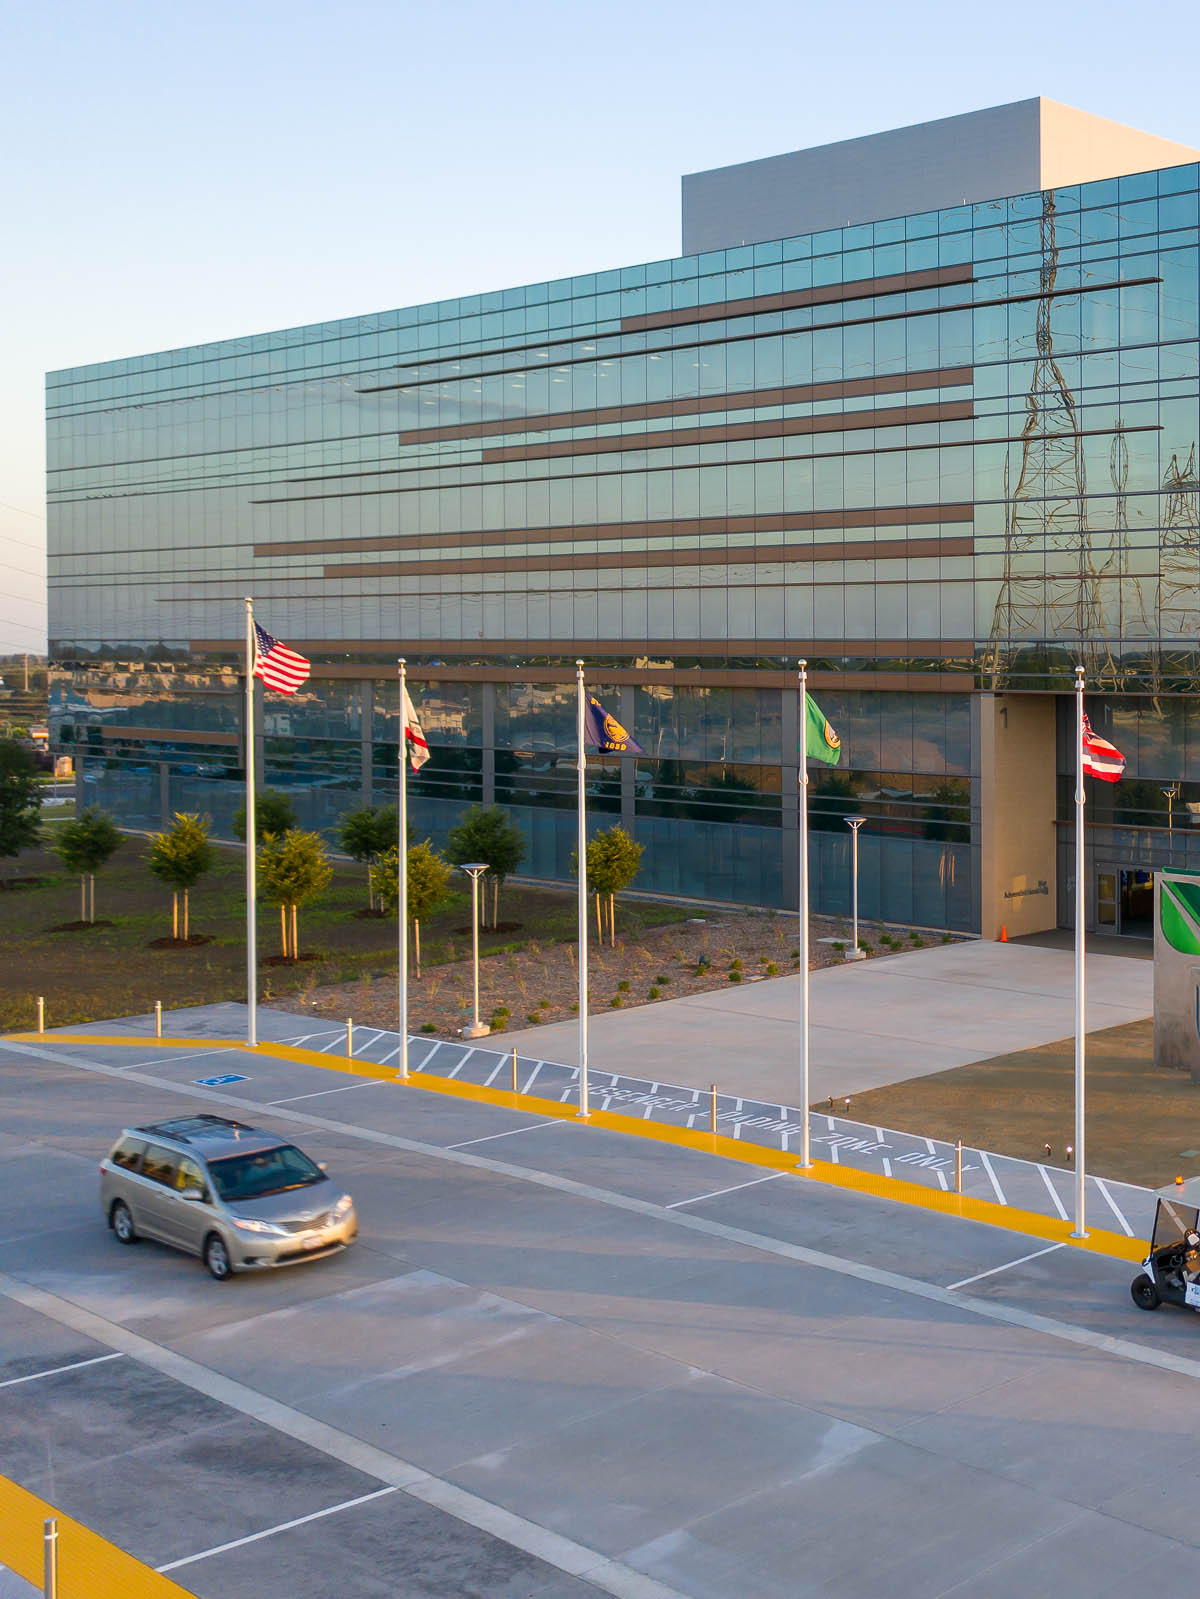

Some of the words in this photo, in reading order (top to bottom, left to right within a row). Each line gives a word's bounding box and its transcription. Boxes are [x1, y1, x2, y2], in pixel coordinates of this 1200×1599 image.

[562, 1083, 700, 1111] PASSENGER
[696, 1108, 810, 1134] LOADING
[810, 1133, 893, 1155] ZONE
[894, 1152, 980, 1175] ONLY
